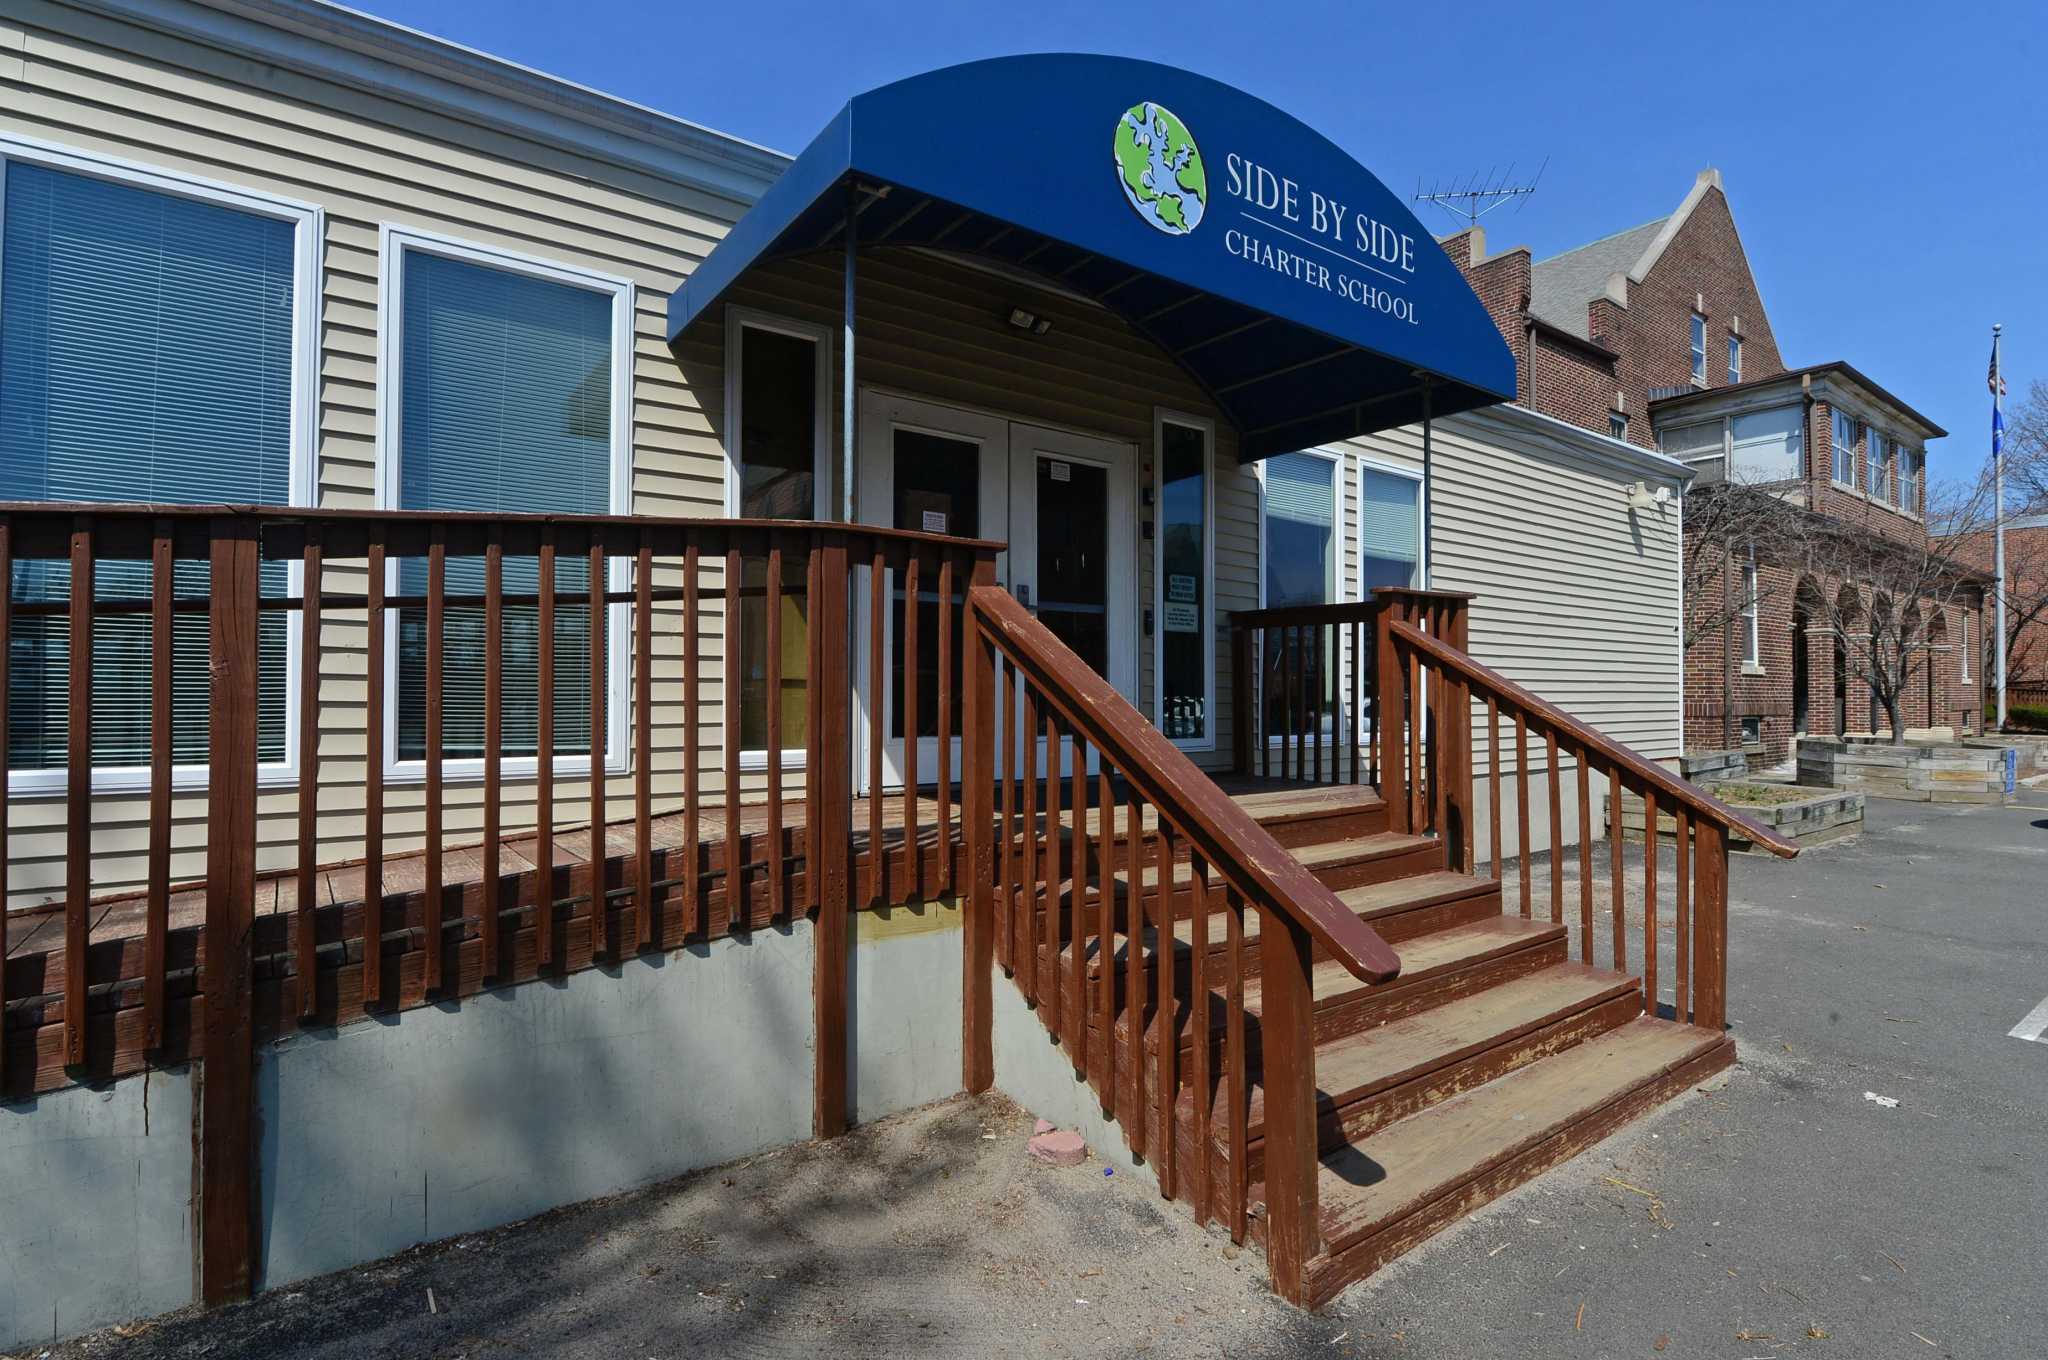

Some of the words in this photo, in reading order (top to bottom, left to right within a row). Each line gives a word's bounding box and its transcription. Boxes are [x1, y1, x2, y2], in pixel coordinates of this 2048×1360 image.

[1226, 152, 1300, 223] SIDE
[1310, 191, 1348, 242] BY
[1355, 213, 1416, 274] SIDE
[1225, 229, 1332, 292] CHARTER
[1337, 274, 1419, 326] SCHOOL
